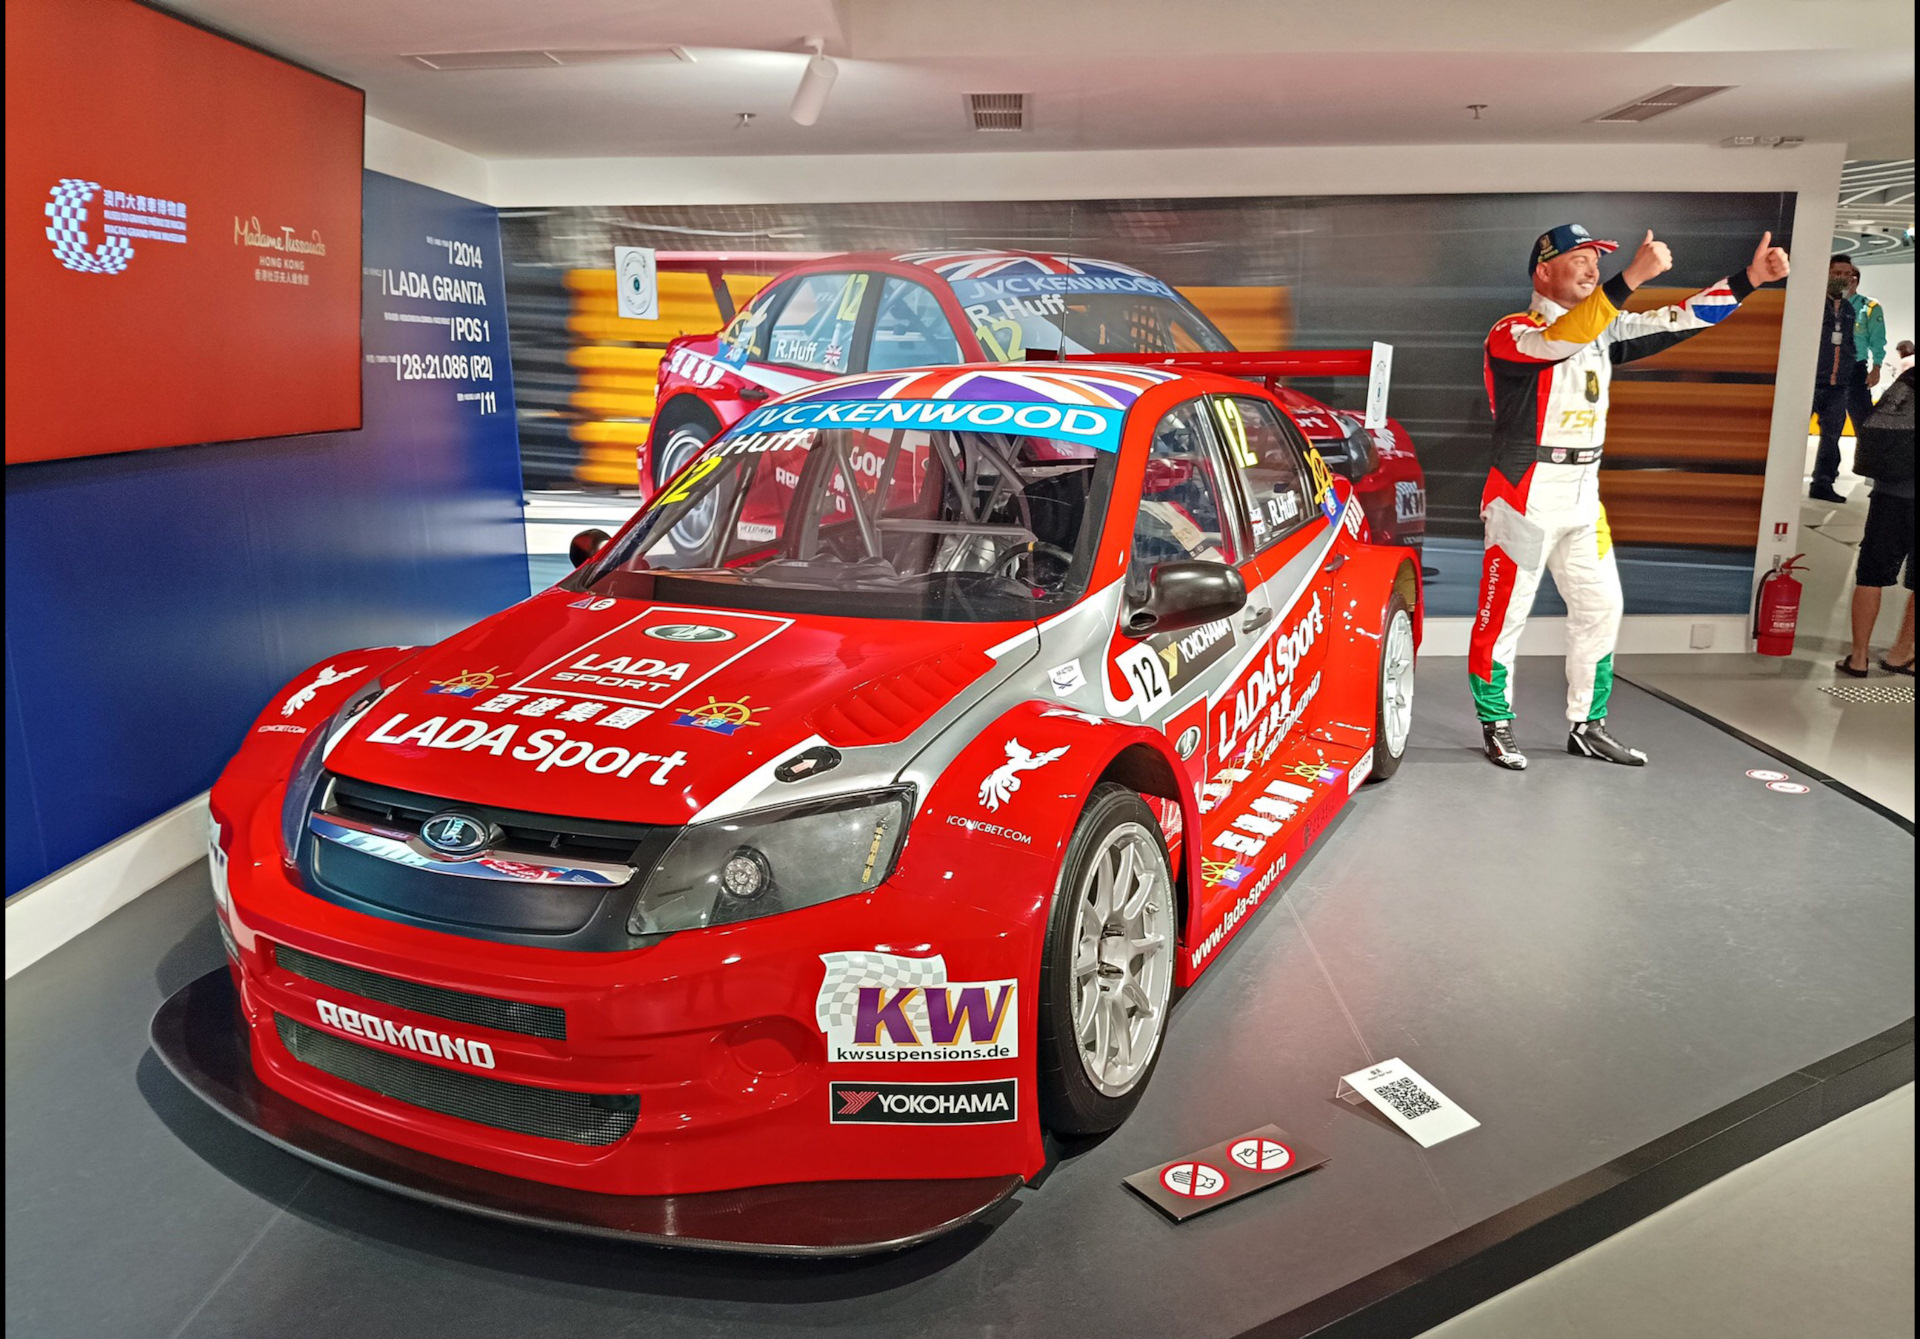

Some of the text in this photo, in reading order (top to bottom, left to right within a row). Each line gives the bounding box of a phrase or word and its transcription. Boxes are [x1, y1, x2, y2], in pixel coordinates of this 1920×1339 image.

[234, 216, 326, 256] Madame Tussauds
[259, 256, 304, 270] HONG KONG
[454, 241, 482, 269] 2014
[388, 269, 487, 306] LADA GRANTA
[455, 317, 482, 342] POS
[483, 320, 490, 342] 1
[775, 340, 819, 362] R.Huff
[402, 354, 493, 381] 28:21.086 (R2)
[485, 391, 496, 413] 11
[735, 402, 1107, 435] JVCKENWOOD
[1214, 398, 1259, 468] 12
[1177, 617, 1231, 664] YOKOHAMA
[551, 671, 671, 692] SPORT
[569, 653, 690, 681] LADA
[1133, 656, 1162, 702] 12
[1219, 653, 1277, 761] LADA
[1276, 592, 1324, 686] Sport
[365, 713, 688, 786] LADA Sport
[946, 815, 1032, 844] ICONICBET.COM
[1191, 852, 1287, 969] www.lada-sport.ru
[853, 984, 1015, 1046] KW
[837, 1045, 1010, 1061] kwsuspensions.de
[878, 1092, 1009, 1113] YOKOHAMA
